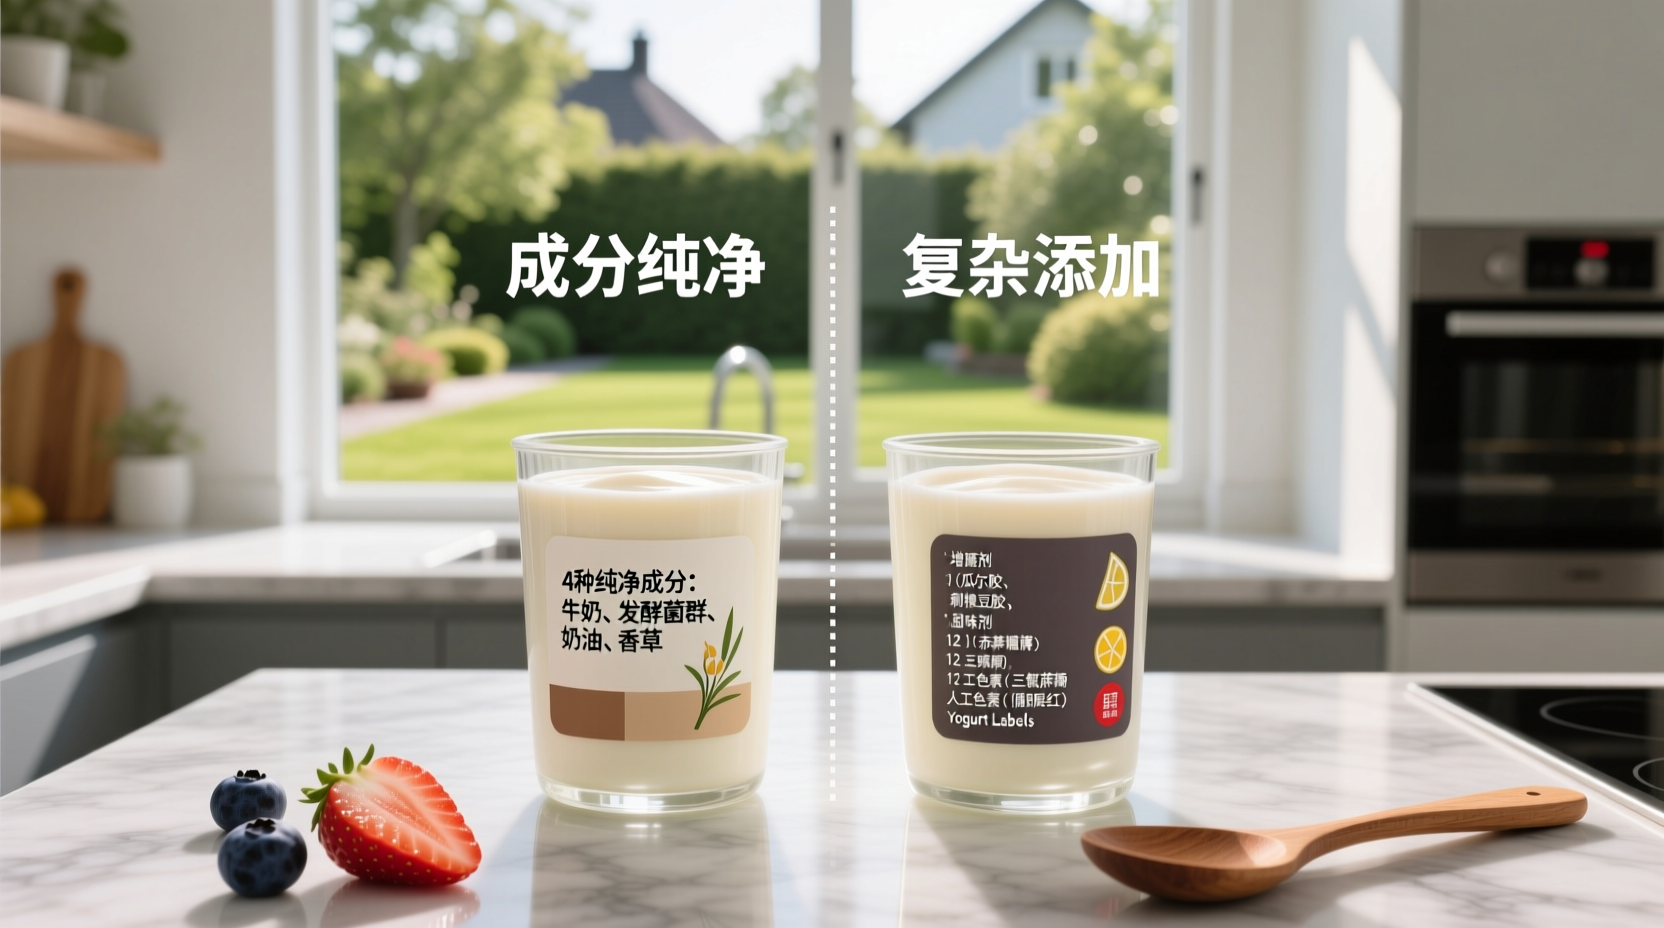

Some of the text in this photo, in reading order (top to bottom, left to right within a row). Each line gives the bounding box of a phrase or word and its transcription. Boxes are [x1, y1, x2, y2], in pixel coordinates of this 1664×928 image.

[561, 568, 697, 595] 4种纯净成分：
[561, 598, 716, 625] 牛奶、发酵菌群、
[561, 626, 663, 653] 奶油、香草
[947, 710, 1035, 729] Yogurt Labels
